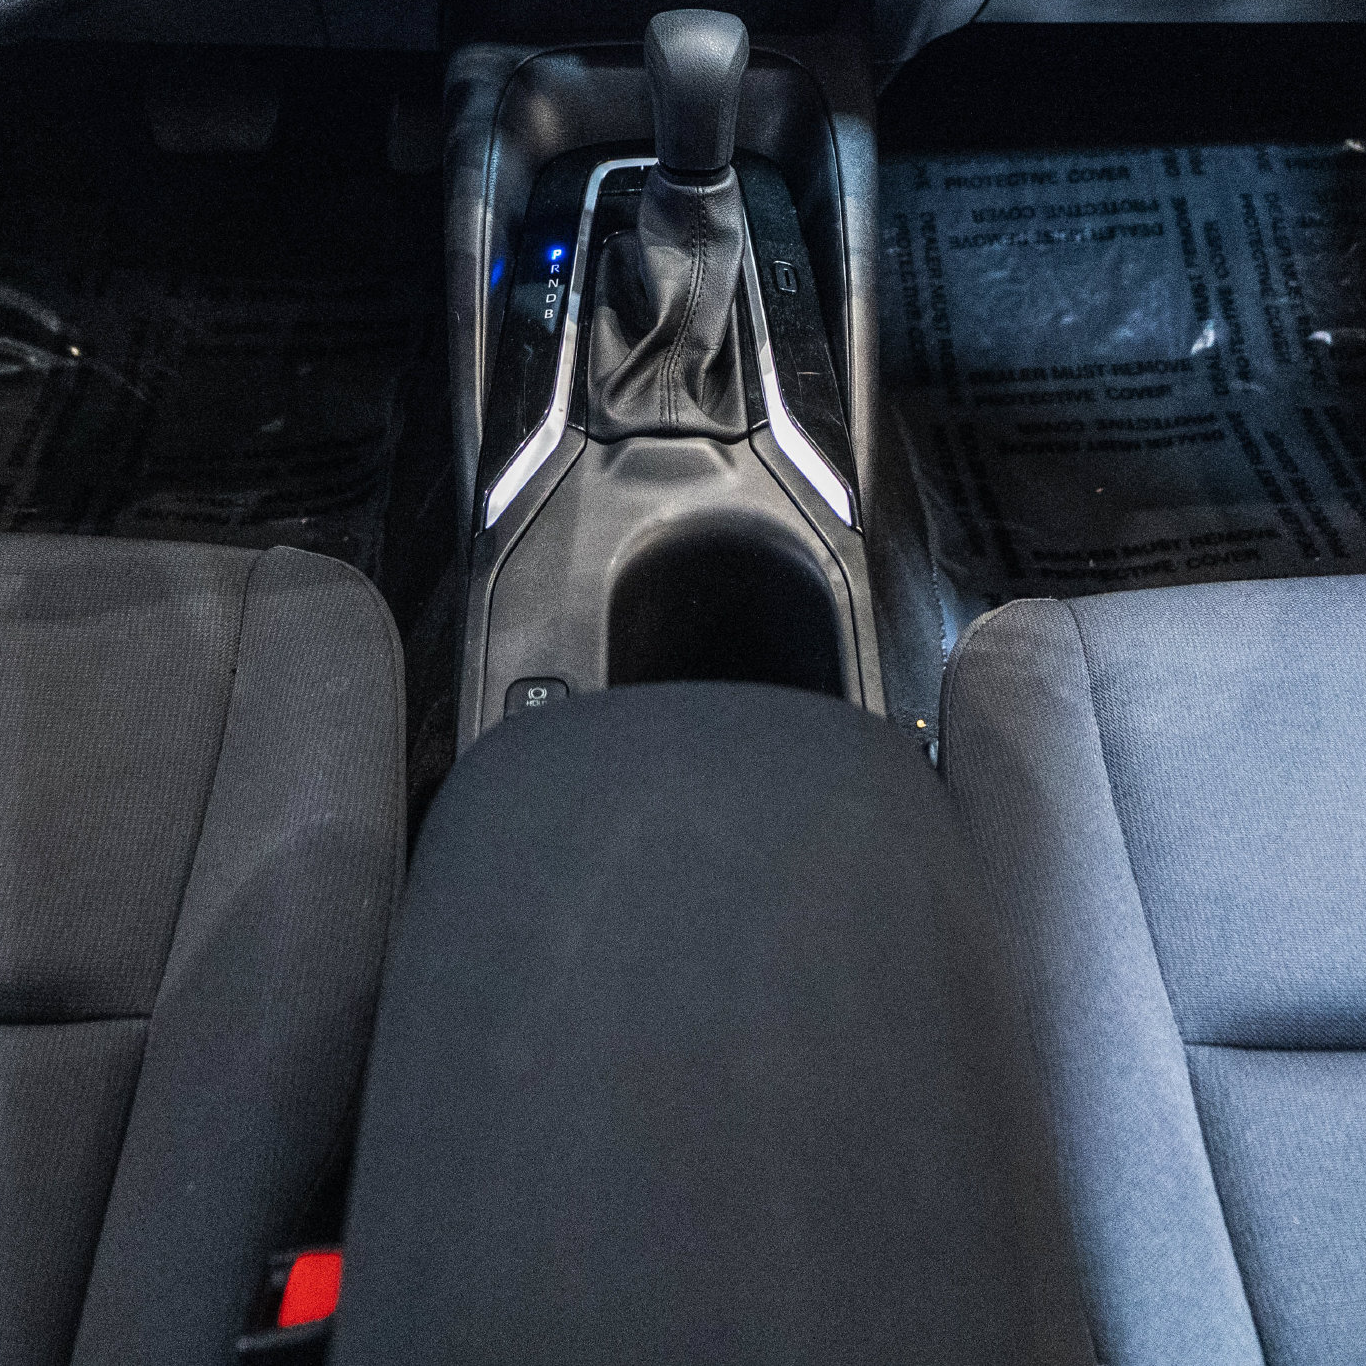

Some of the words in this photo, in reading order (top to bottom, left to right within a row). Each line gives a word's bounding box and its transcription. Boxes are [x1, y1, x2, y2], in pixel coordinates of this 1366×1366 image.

[1067, 166, 1131, 184] COVER
[551, 249, 562, 260] P
[550, 264, 560, 274] R
[548, 278, 559, 288] N
[546, 294, 557, 303] D
[544, 309, 554, 319] B
